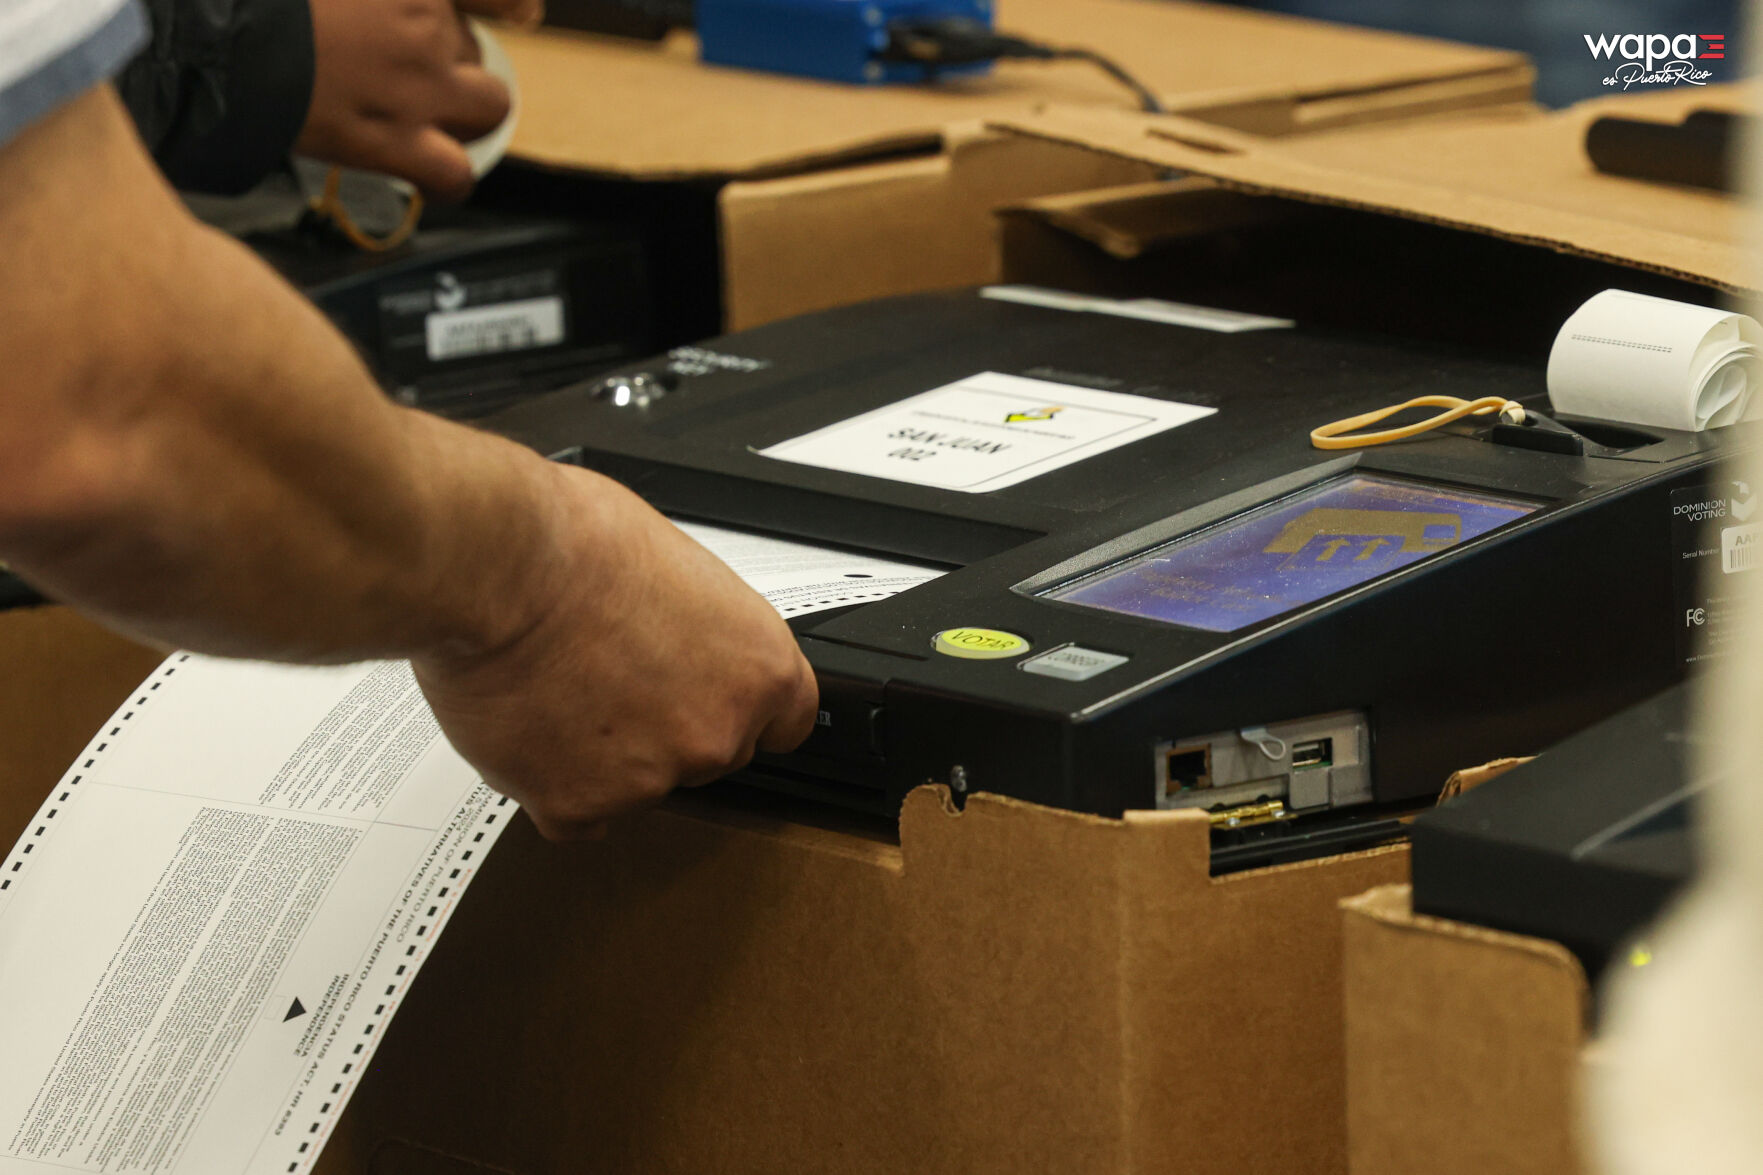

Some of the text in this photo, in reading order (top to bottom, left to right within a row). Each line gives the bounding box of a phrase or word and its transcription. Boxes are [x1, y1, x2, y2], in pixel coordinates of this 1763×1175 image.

[888, 428, 1012, 454] SAN JUAN
[1673, 499, 1726, 516] DOMINION
[1687, 508, 1726, 522] VOTING
[1682, 550, 1698, 560] Serial
[951, 631, 1015, 651] VOTAR
[412, 808, 465, 886] ALTERNATIVES
[402, 889, 412, 903] OF
[387, 908, 401, 929] THE
[396, 914, 415, 942] RICO
[360, 933, 388, 979] PUERTO
[343, 983, 361, 1010] RICO
[294, 975, 339, 1055] INDEPENDENCE
[301, 974, 349, 1057] INDEPENDENCIA
[318, 1014, 344, 1058] STATUS
[291, 1090, 302, 1106] HR
